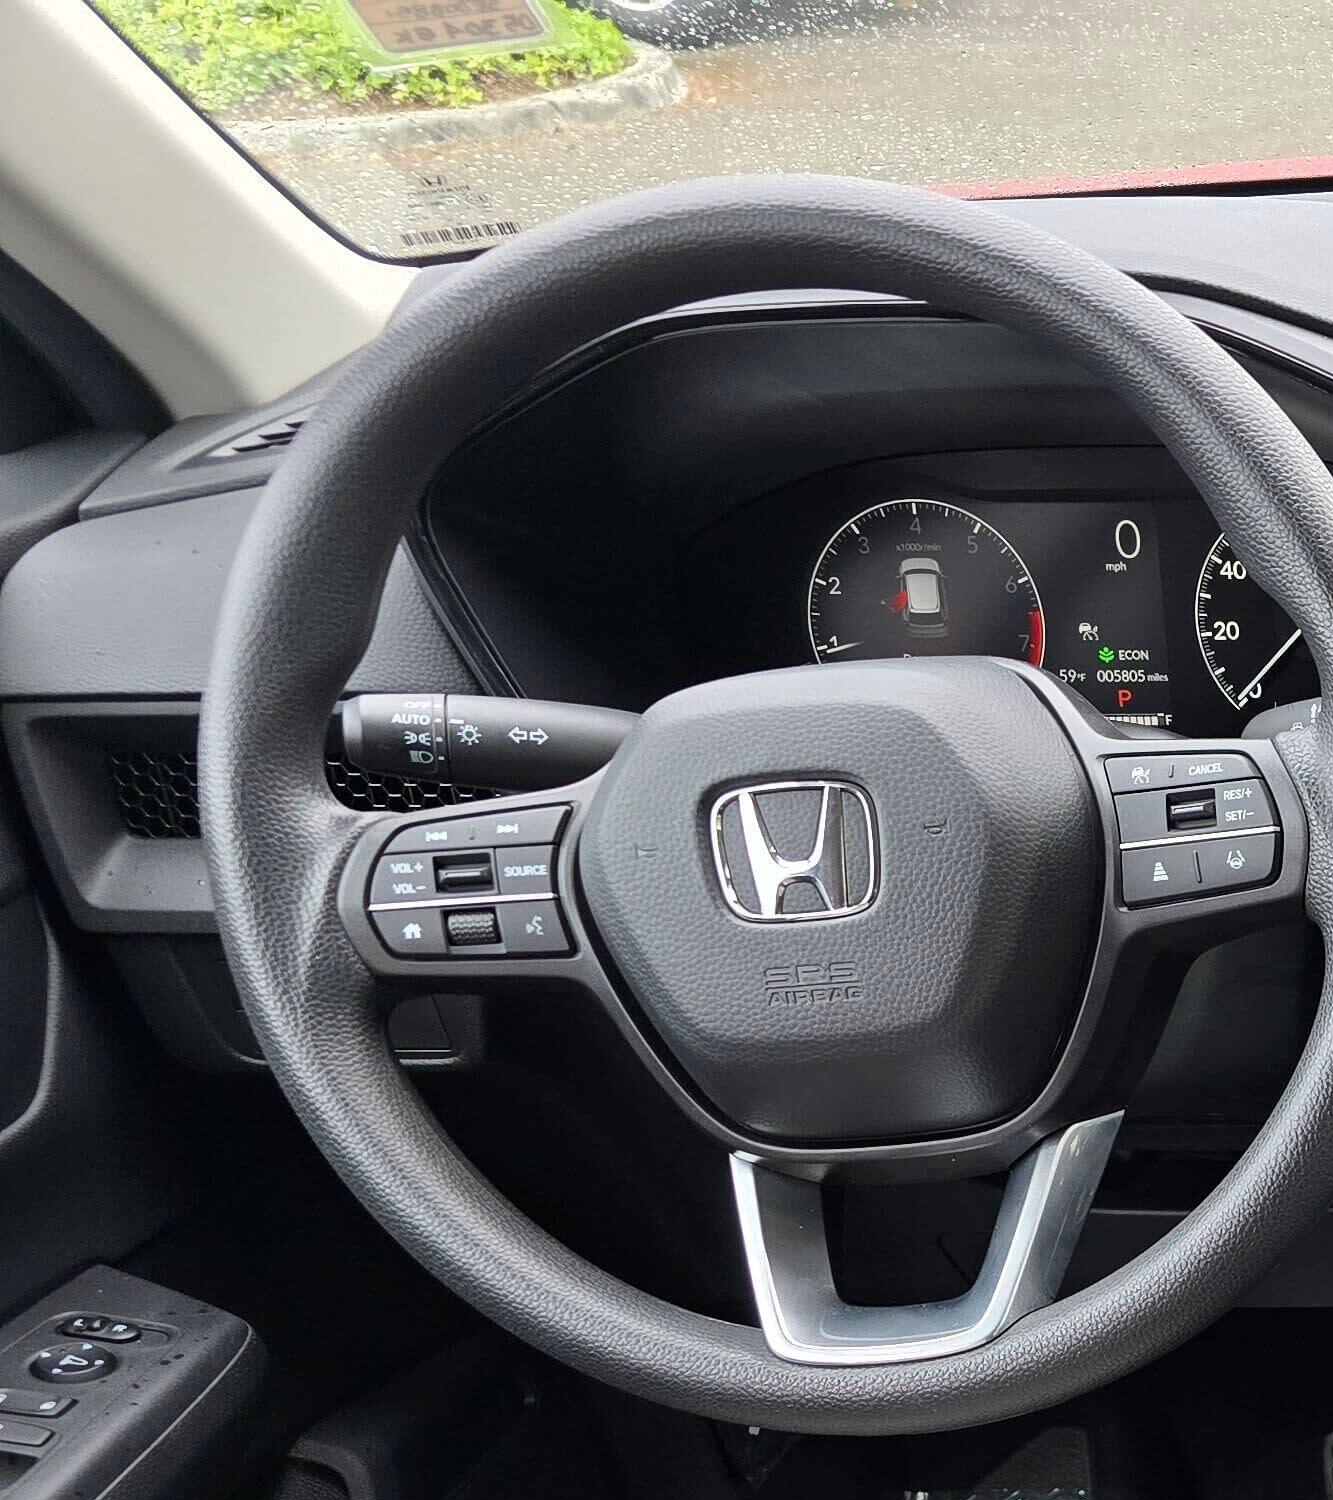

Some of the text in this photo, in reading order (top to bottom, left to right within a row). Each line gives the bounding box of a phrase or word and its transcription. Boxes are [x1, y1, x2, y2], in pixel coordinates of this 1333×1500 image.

[1105, 562, 1127, 573] mph
[1219, 560, 1247, 580] 40
[828, 576, 842, 595] 2
[1212, 620, 1240, 641] 20
[1118, 649, 1149, 661] ECON
[1096, 668, 1146, 684] 005805
[1147, 672, 1169, 683] miles
[1117, 689, 1132, 708] P
[391, 712, 431, 726] AUTO
[1188, 762, 1223, 776] CANCEL
[504, 864, 548, 877] SOURCE
[764, 961, 858, 985] SRS
[767, 985, 863, 1007] AIRBAG
